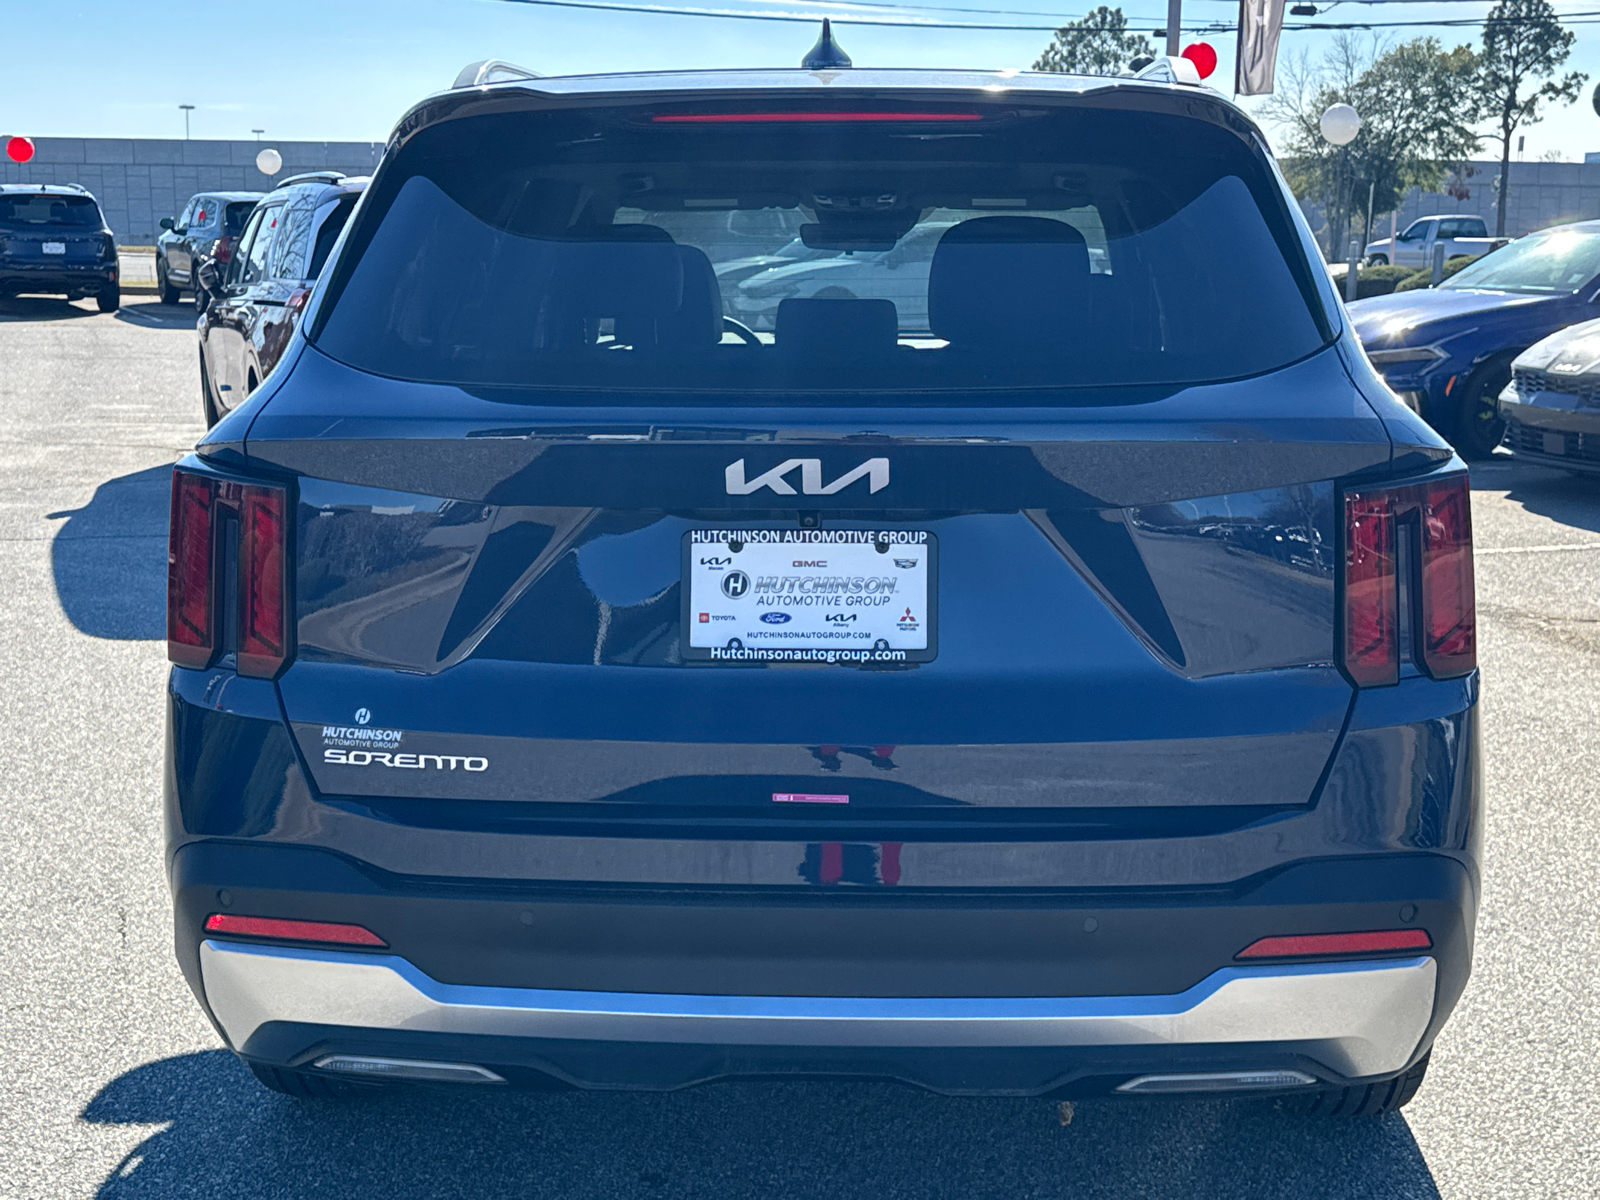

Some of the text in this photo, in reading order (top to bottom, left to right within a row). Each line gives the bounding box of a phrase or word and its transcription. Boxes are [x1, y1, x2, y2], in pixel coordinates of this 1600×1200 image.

[725, 457, 890, 495] KIA
[691, 530, 927, 543] HUTCHINSON AUTOMOTIVE GROUP
[792, 560, 827, 568] GMC
[754, 576, 897, 594] HUTCHINSON
[756, 595, 890, 606] AUTOMOTIVE GROUP
[747, 631, 871, 639] HUTCHINSONAUTOGROUP.COM
[711, 647, 906, 663] Hutchinsonautogroup.com
[321, 726, 402, 742] HUTCHINSON
[323, 738, 399, 749] AUTOMOTIVE GROUP
[324, 749, 488, 772] SORENTO
